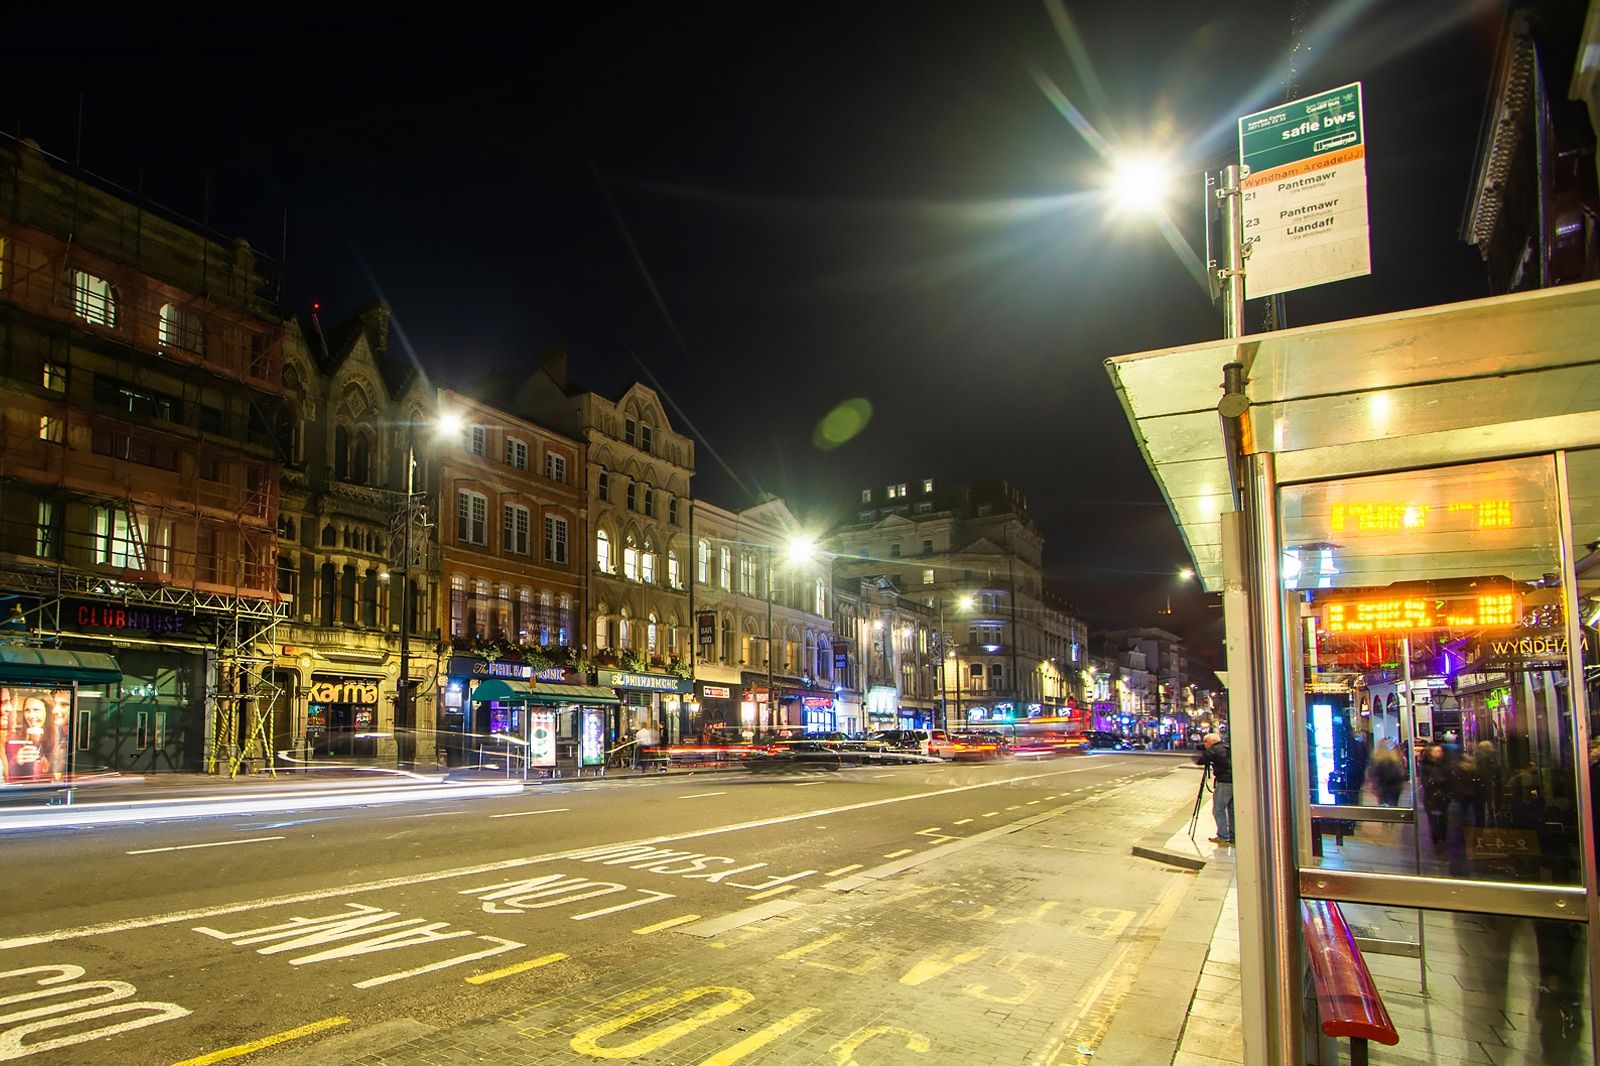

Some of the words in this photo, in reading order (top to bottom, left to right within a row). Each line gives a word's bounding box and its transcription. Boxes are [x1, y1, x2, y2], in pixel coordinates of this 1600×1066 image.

[1282, 120, 1320, 140] safle
[1324, 110, 1356, 128] bws
[1244, 169, 1298, 188] Wyndham
[1278, 171, 1336, 192] Pantmawr
[1244, 192, 1256, 201] 21
[1280, 198, 1339, 219] Pantmawr
[1246, 218, 1260, 228] 23
[1286, 217, 1334, 236] Llandaff
[1246, 236, 1262, 245] 24
[1358, 602, 1401, 612] Cardiff
[1404, 600, 1425, 610] Bay
[1358, 611, 1401, 620] Cardiff
[1405, 610, 1425, 620] Bay
[78, 606, 184, 634] CLUBHOUSE
[1330, 622, 1344, 631] St
[1348, 622, 1372, 631] Mary
[1376, 620, 1413, 630] Street
[1448, 617, 1474, 626] Time
[700, 626, 712, 635] BAR
[472, 662, 488, 674] The
[488, 662, 566, 680] PHILHMONIC
[625, 675, 678, 689] PHILHARMONIC
[308, 682, 378, 704] karma
[570, 845, 818, 891] FYSIAU
[458, 873, 676, 921] LÔN
[191, 902, 527, 989] LANE
